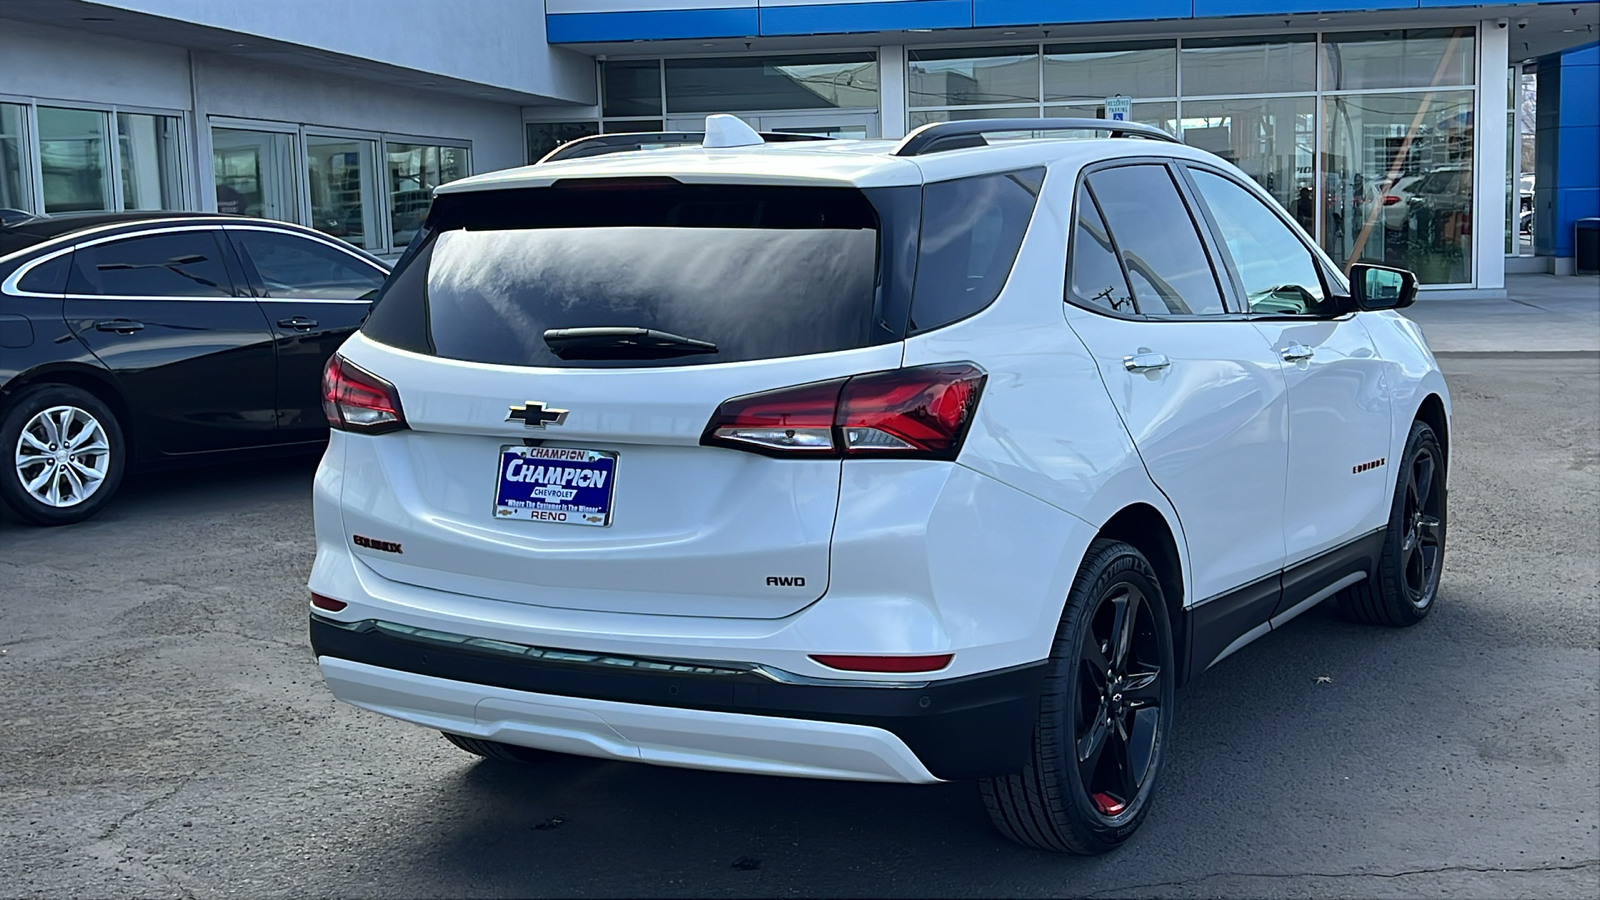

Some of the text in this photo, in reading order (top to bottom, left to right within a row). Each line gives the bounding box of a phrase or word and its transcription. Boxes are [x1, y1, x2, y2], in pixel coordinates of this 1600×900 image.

[530, 448, 586, 461] CHAMPION
[505, 458, 608, 488] CHAMPION
[534, 488, 573, 498] CHEVROLET
[526, 501, 535, 509] The
[536, 502, 561, 510] Customer
[568, 504, 578, 512] The
[530, 510, 567, 522] RENO
[766, 576, 806, 587] AWD
